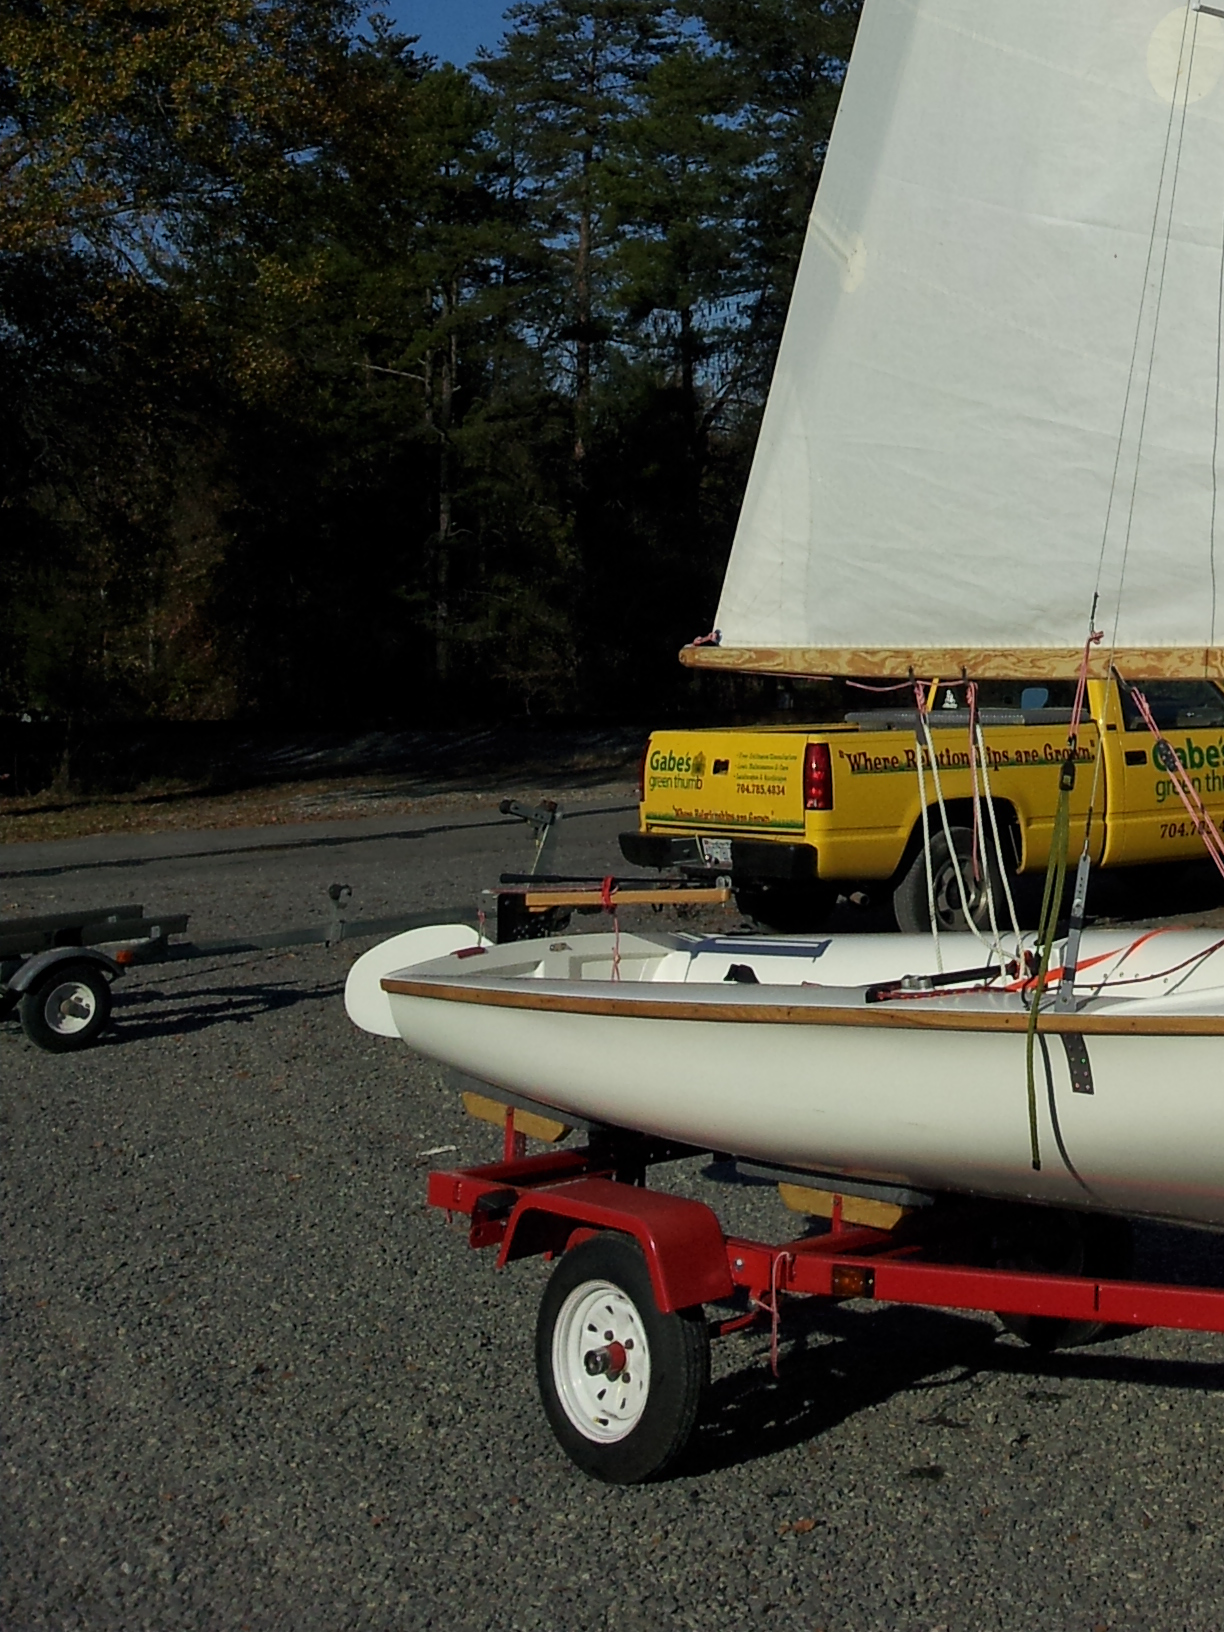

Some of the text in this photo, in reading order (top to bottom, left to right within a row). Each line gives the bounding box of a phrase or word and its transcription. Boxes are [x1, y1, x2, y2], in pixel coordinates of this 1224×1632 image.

[650, 750, 692, 773] Gabe's
[903, 746, 1009, 772] Rltionhips
[1015, 747, 1039, 765] are
[649, 773, 703, 791] green thumb
